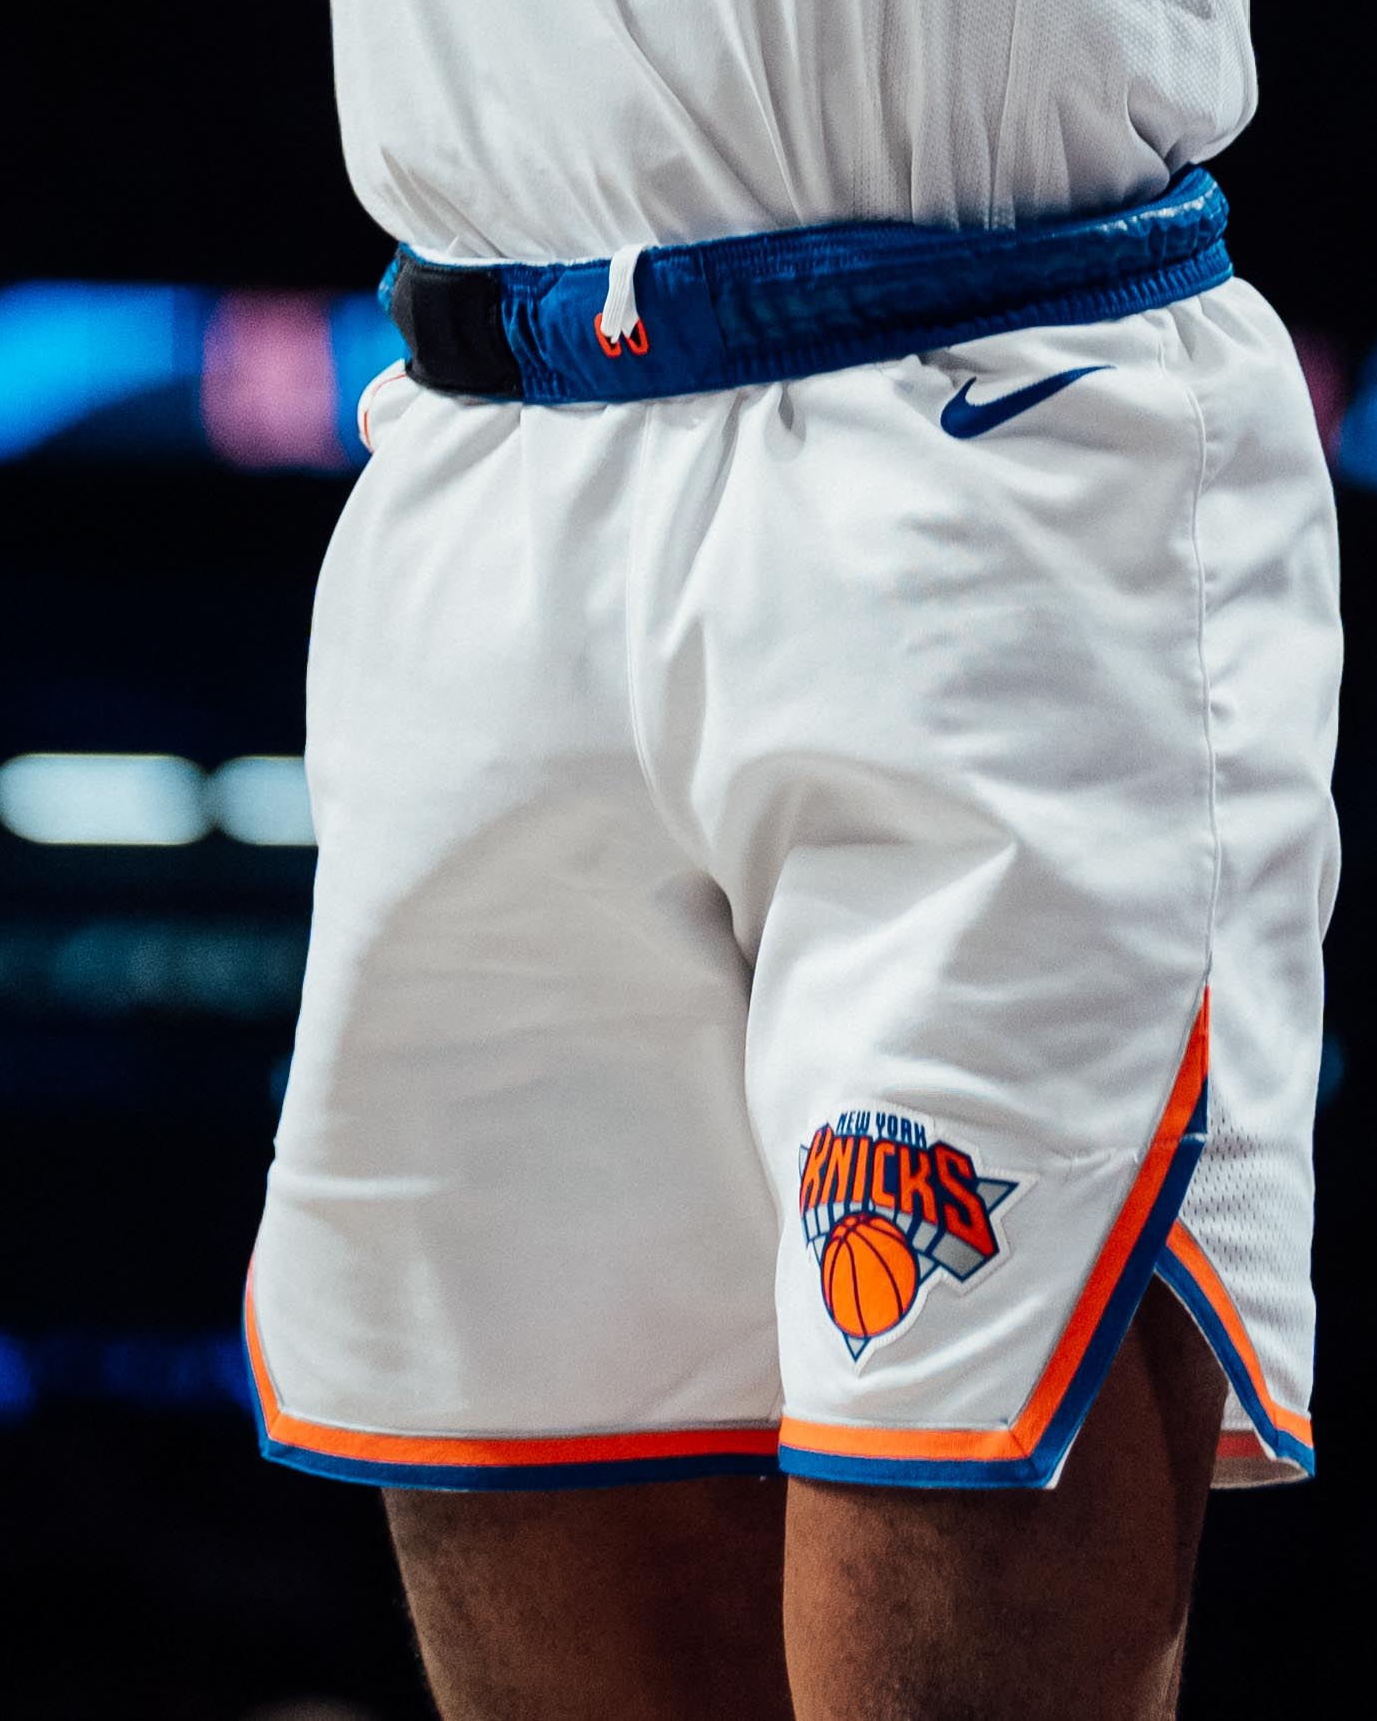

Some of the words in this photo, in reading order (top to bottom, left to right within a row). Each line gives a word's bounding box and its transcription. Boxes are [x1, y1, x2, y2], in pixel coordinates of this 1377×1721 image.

[835, 1110, 871, 1136] NEW
[875, 1111, 928, 1149] YORK
[798, 1122, 998, 1258] KNICKS
